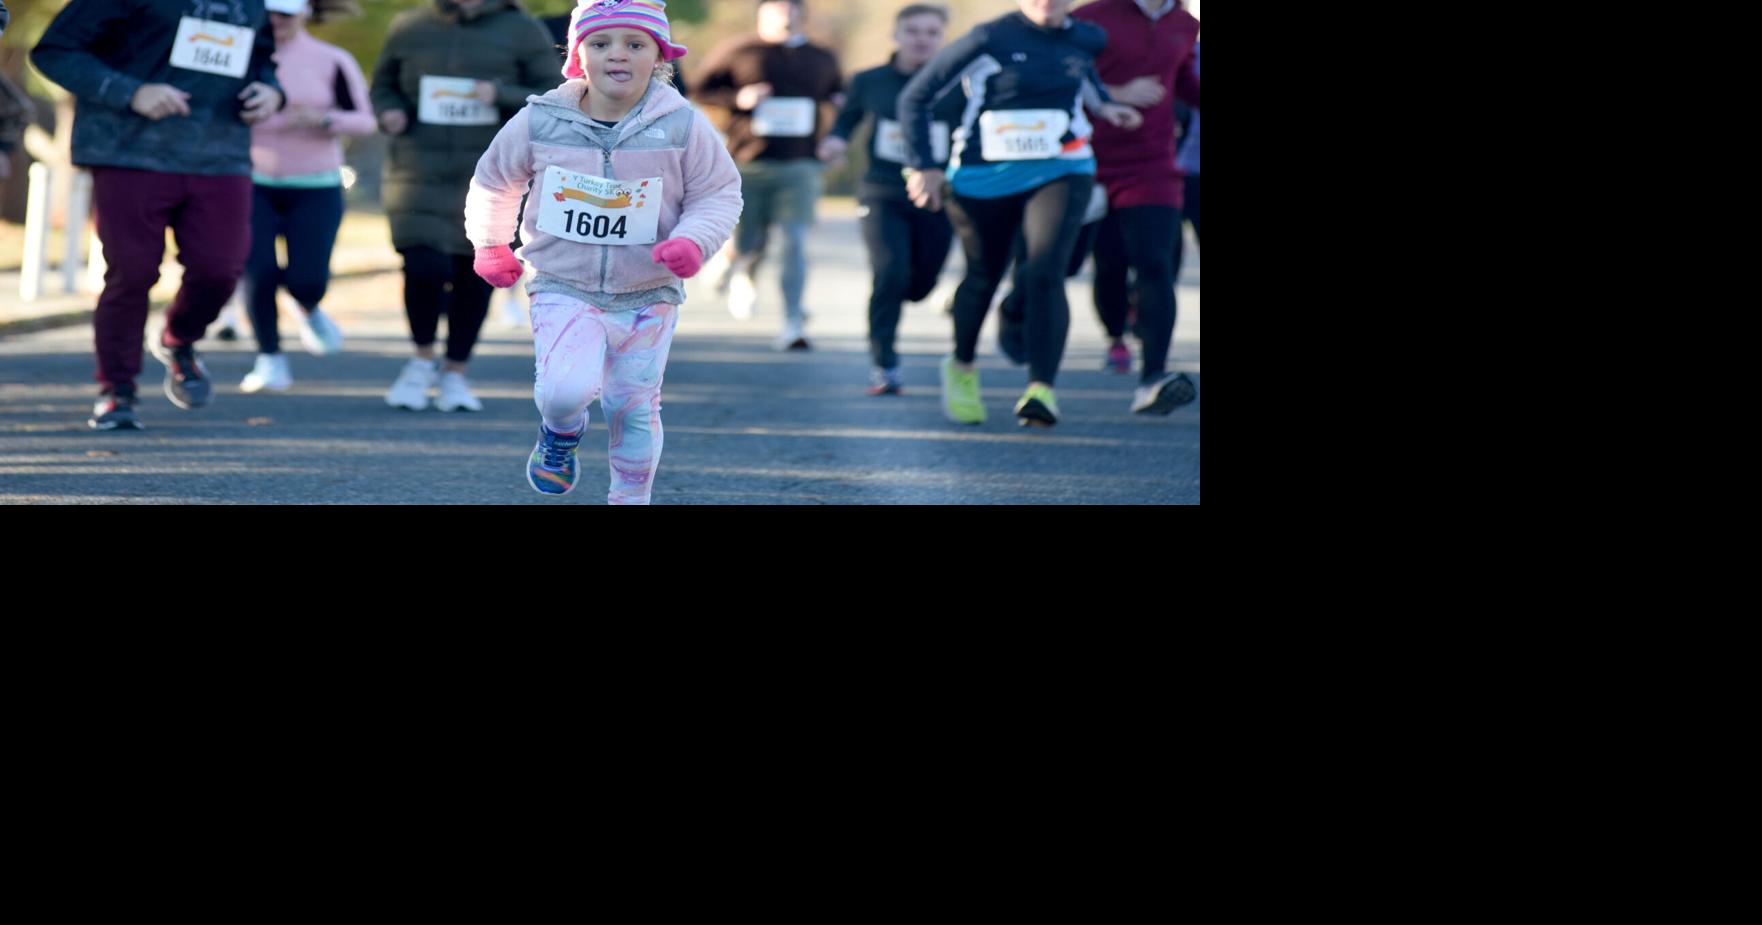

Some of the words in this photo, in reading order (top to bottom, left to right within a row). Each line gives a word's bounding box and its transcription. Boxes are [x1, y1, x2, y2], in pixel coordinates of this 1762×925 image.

[577, 182, 603, 195] Charity
[581, 176, 603, 188] Turkey
[563, 209, 627, 239] 1604
